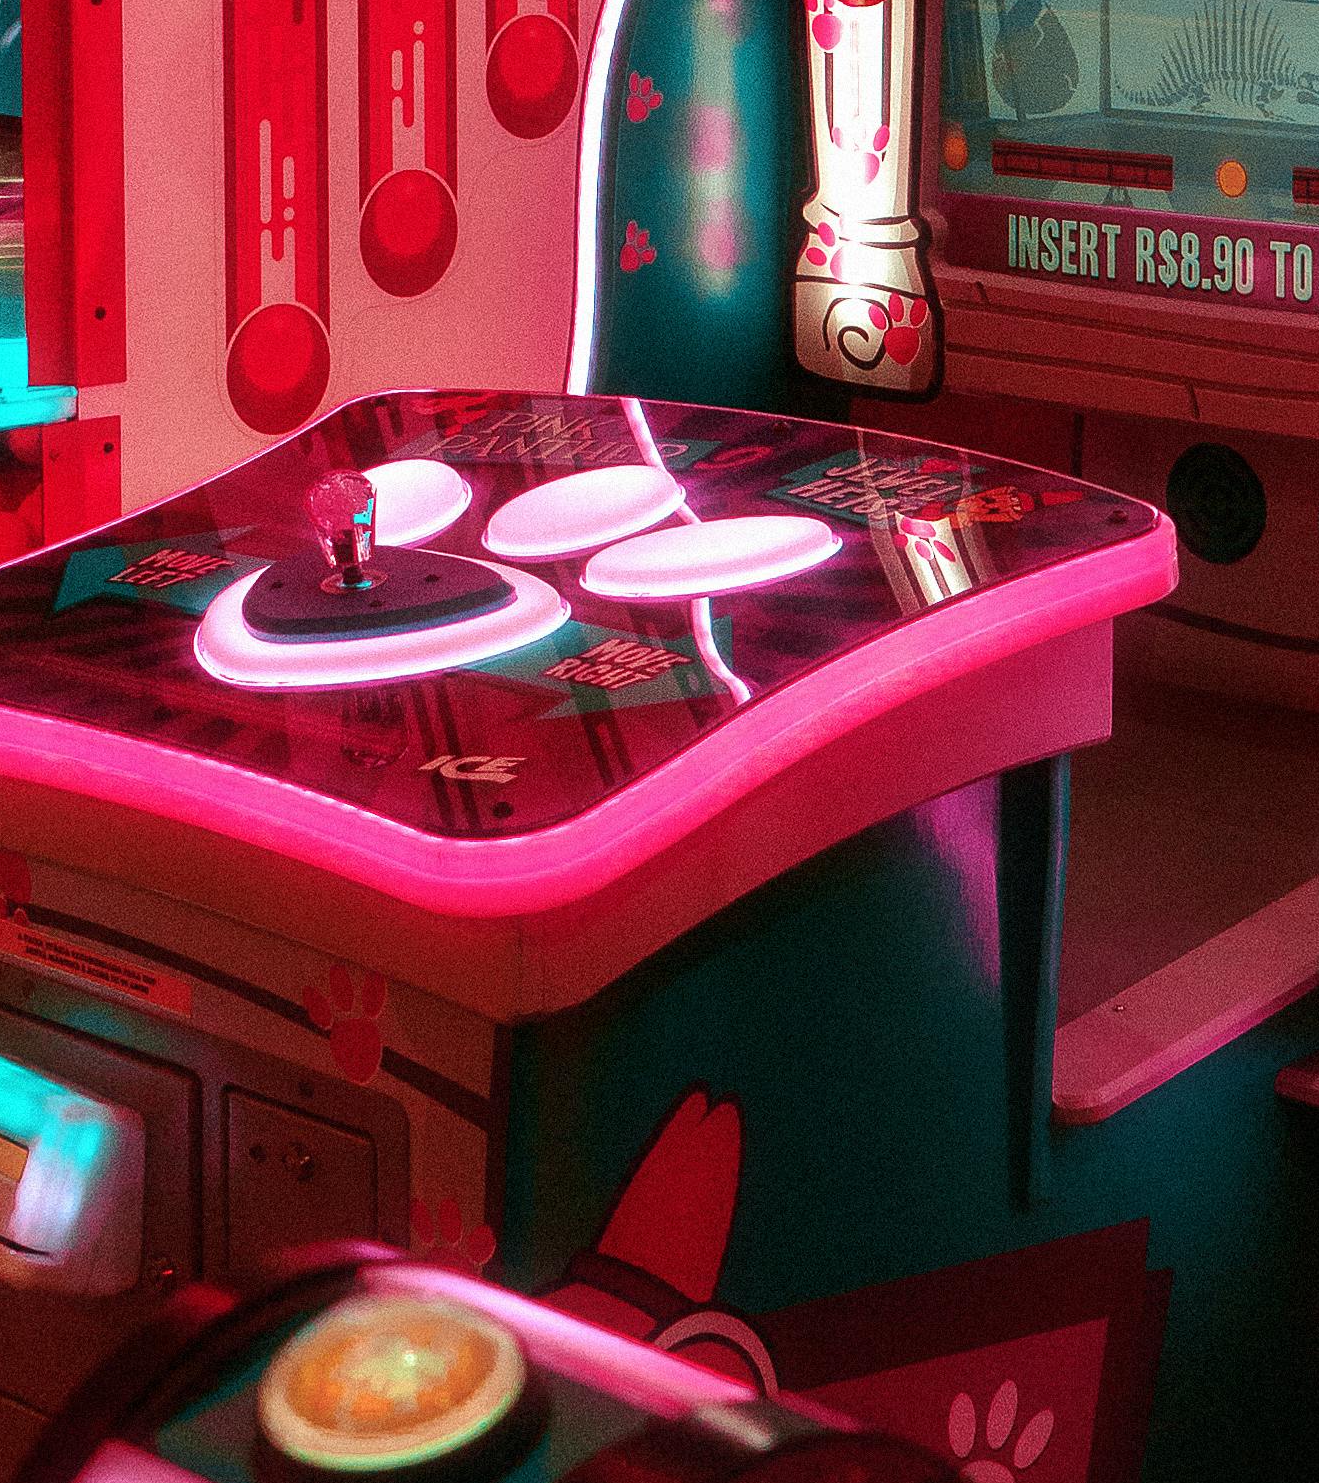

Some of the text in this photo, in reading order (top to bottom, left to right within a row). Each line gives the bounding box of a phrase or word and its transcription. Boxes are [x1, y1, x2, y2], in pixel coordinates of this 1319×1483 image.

[1008, 214, 1121, 280] INSERT
[1135, 226, 1254, 293] R$8.90
[1270, 242, 1313, 300] TO
[139, 548, 235, 574] MOVE
[107, 565, 196, 589] LEFT
[582, 637, 693, 674] MOVE
[544, 657, 652, 690] RIGHT
[418, 755, 530, 784] ICE
